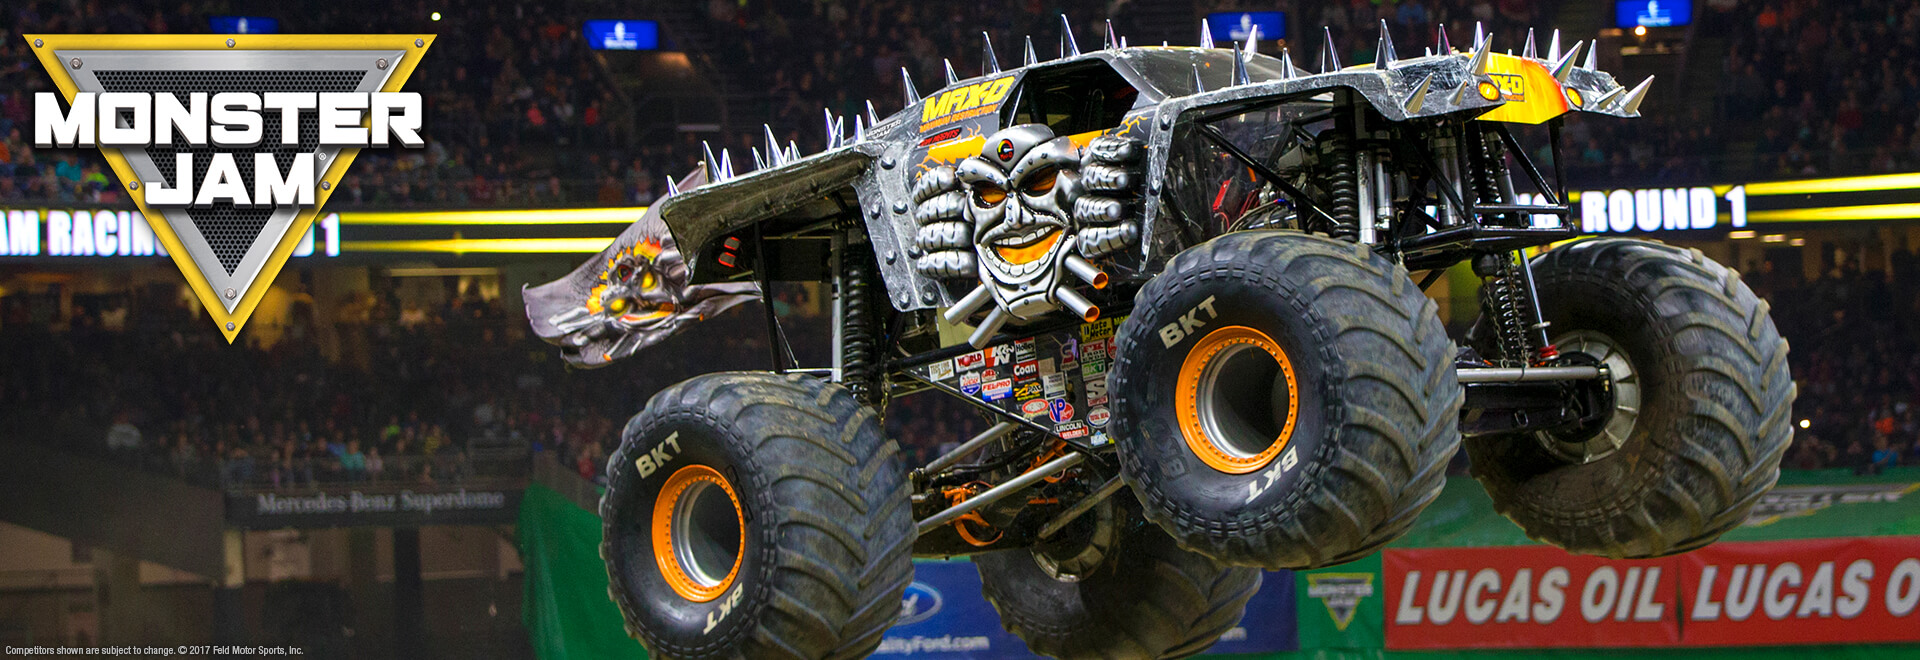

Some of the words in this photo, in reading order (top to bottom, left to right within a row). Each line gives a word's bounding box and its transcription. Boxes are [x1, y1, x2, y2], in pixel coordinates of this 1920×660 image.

[921, 76, 1016, 123] MAX-D
[1580, 187, 1718, 232] ROUND
[1725, 185, 1748, 228] 1
[320, 213, 340, 257] 1
[1158, 294, 1218, 350] BKT
[956, 353, 983, 367] WORLD
[1013, 363, 1037, 376] Coan
[1083, 361, 1105, 377] BKT
[1056, 422, 1082, 433] LINCOLN
[635, 431, 682, 479] BKT
[1245, 445, 1299, 505] BKT
[257, 492, 396, 514] Mercedes-Benz
[401, 488, 505, 515] Superdome
[703, 583, 744, 635] BKT
[1395, 566, 1570, 625] LUCAS
[1580, 565, 1666, 624] OIL
[1691, 558, 1875, 622] LUCAS
